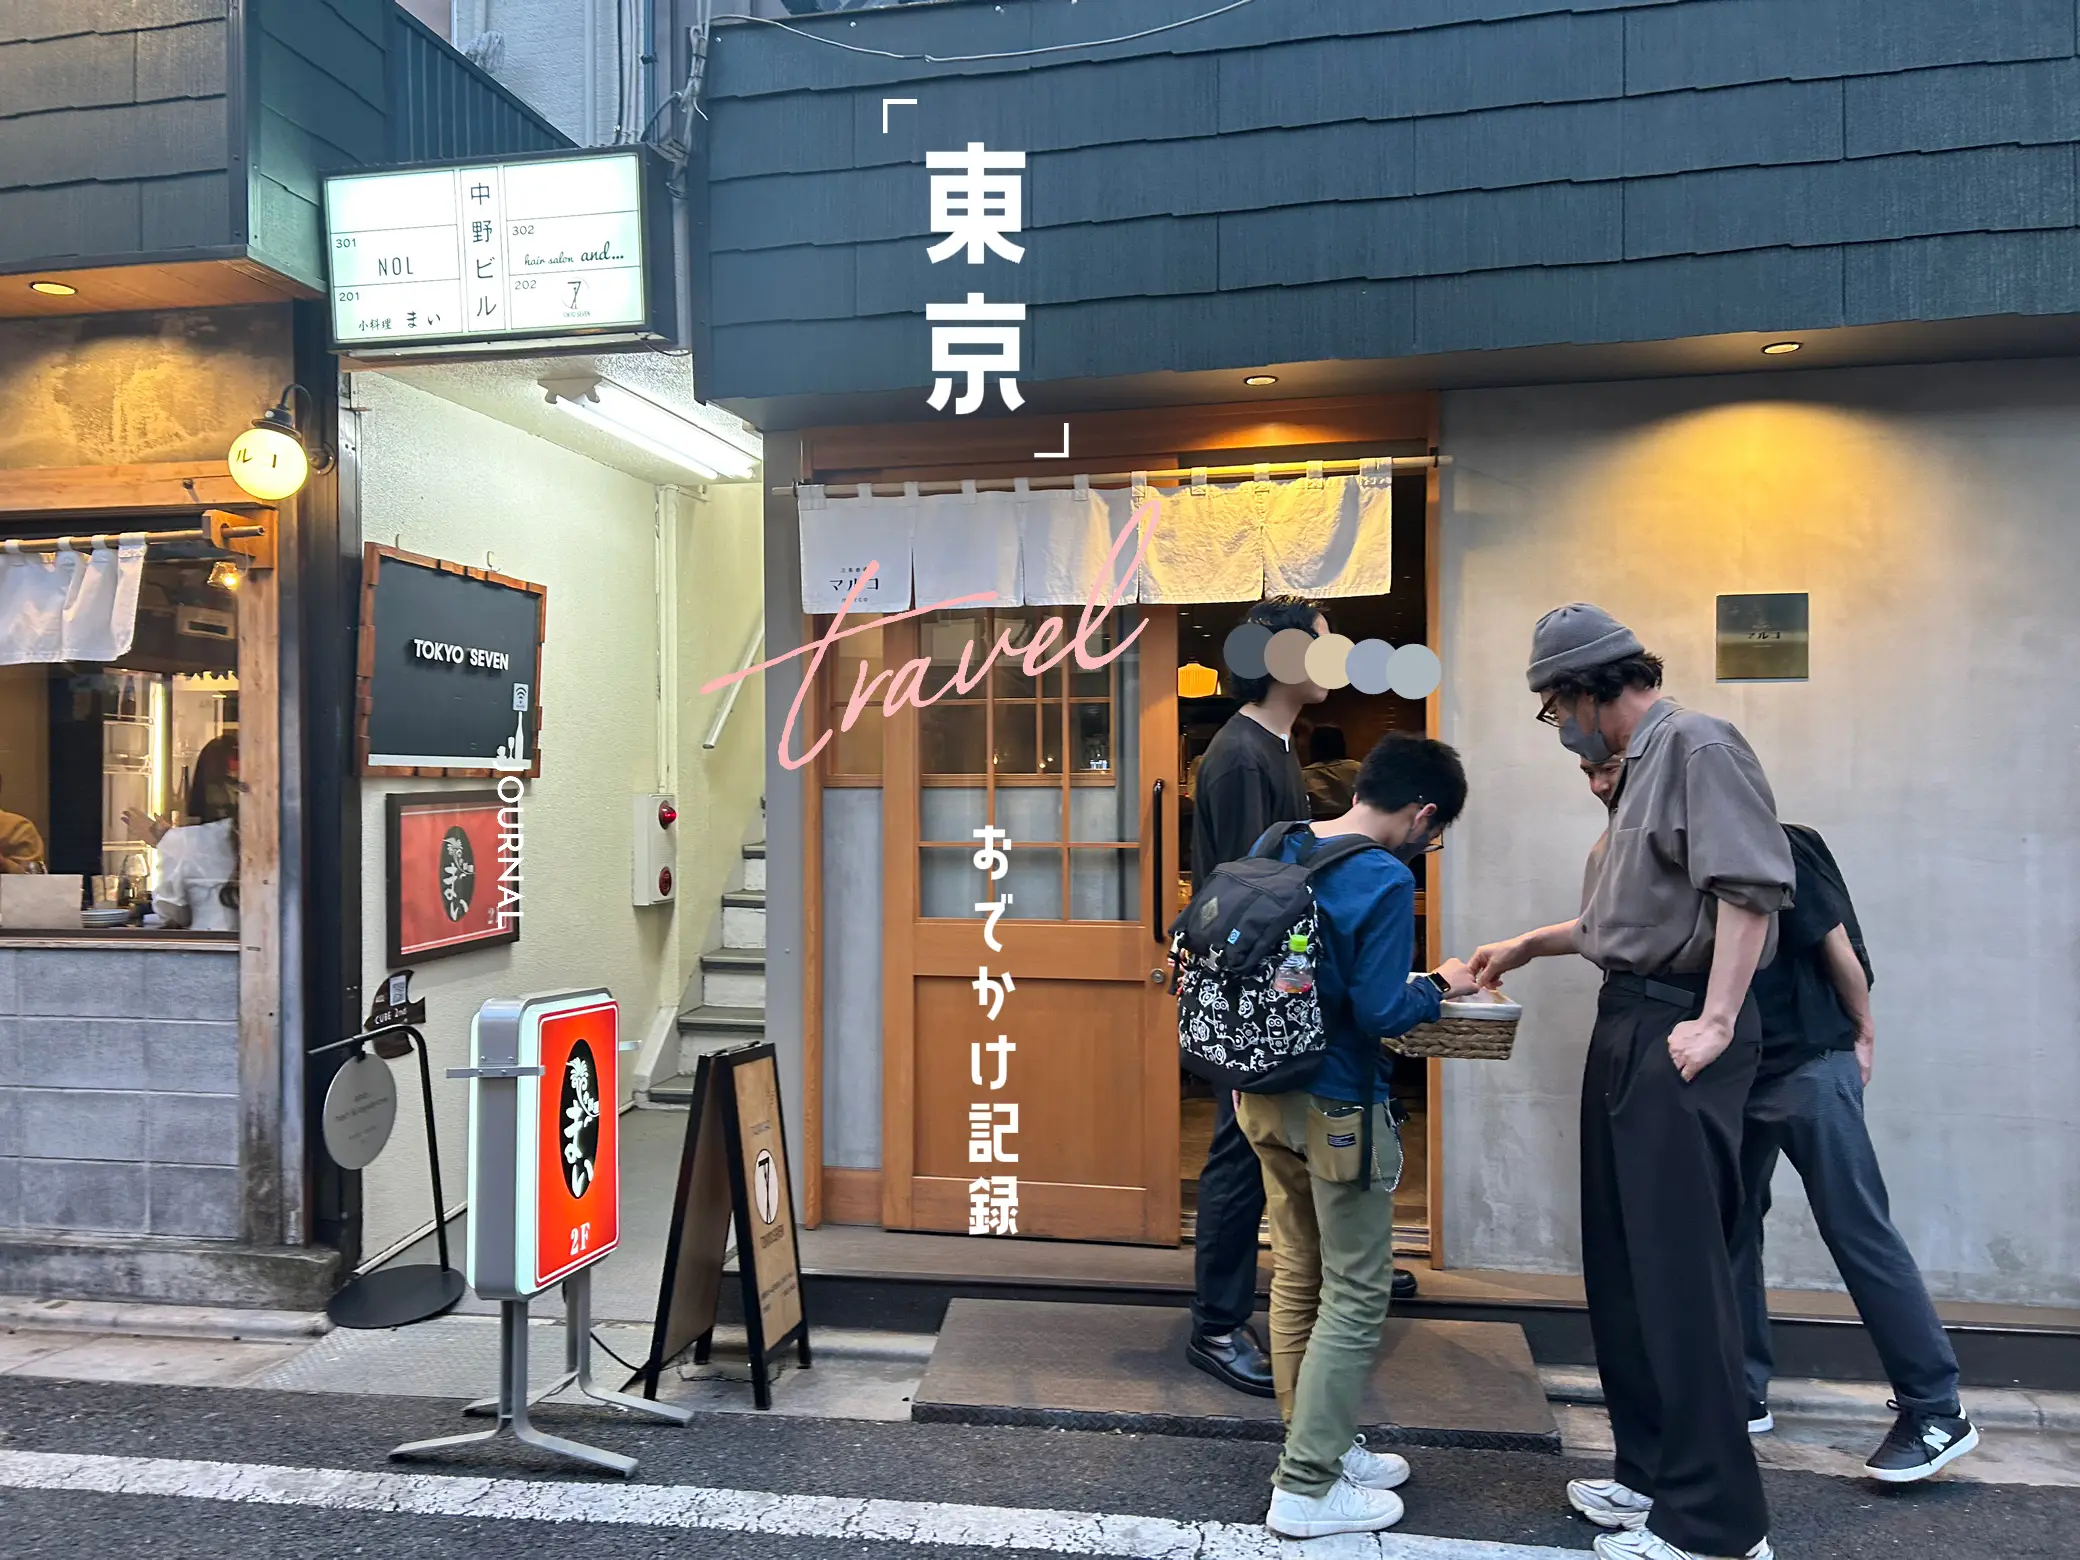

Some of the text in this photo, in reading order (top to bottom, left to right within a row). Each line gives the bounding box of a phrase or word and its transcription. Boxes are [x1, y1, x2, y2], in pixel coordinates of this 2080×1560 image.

[512, 225, 535, 235] 302
[335, 238, 357, 248] 301
[470, 182, 497, 317] 中野ビル
[378, 256, 414, 277] NOL
[524, 253, 546, 266] hair
[548, 251, 574, 264] salon
[514, 280, 537, 290] 202
[338, 292, 360, 302] 201
[358, 310, 441, 331] 小料理 まい
[412, 638, 510, 671] TOKYO SEVEN
[374, 1011, 392, 1025] CUBE
[569, 1222, 591, 1257] 2F
[1922, 1425, 1952, 1453] N
